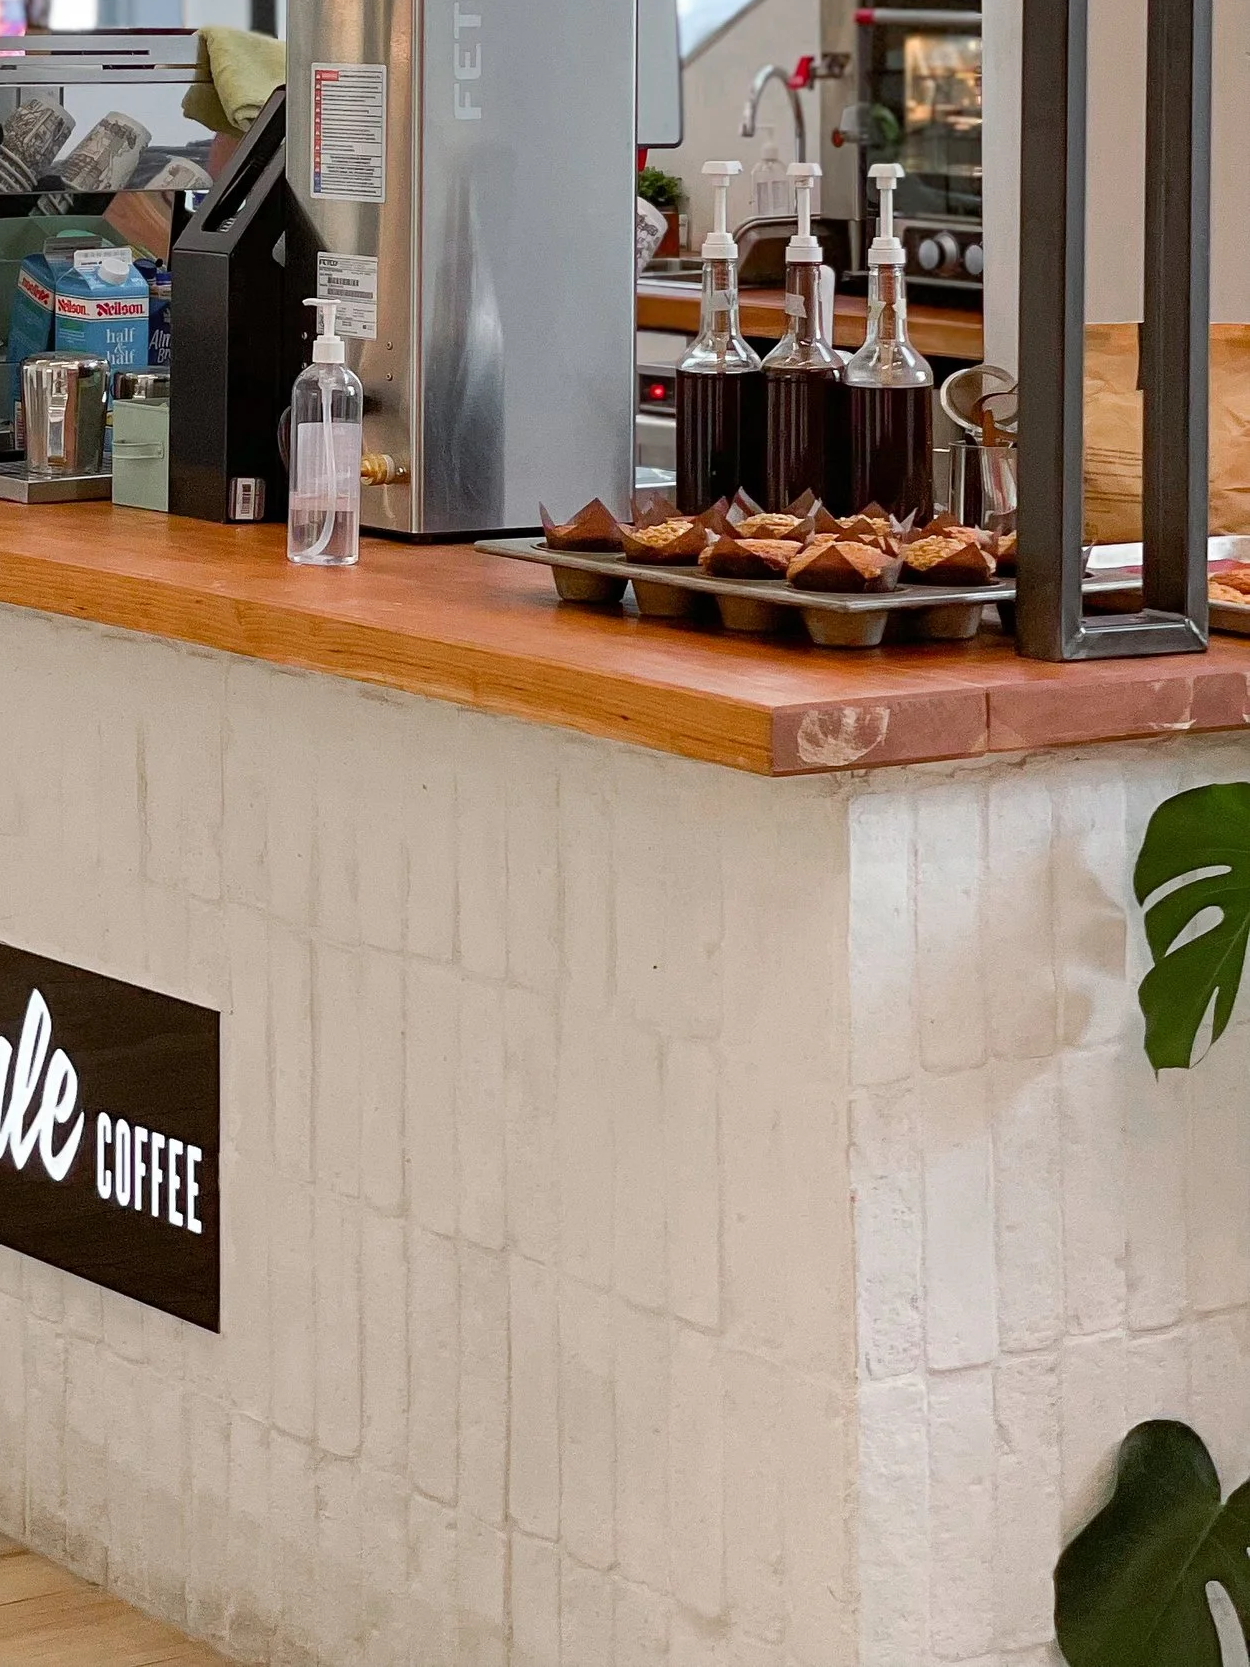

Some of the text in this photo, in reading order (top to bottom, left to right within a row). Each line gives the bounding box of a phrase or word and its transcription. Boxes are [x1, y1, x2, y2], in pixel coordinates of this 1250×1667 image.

[58, 298, 87, 315] Neilson
[96, 302, 143, 317] Neilson
[106, 327, 136, 343] half
[107, 350, 135, 365] half
[96, 1112, 203, 1234] COFFEE
